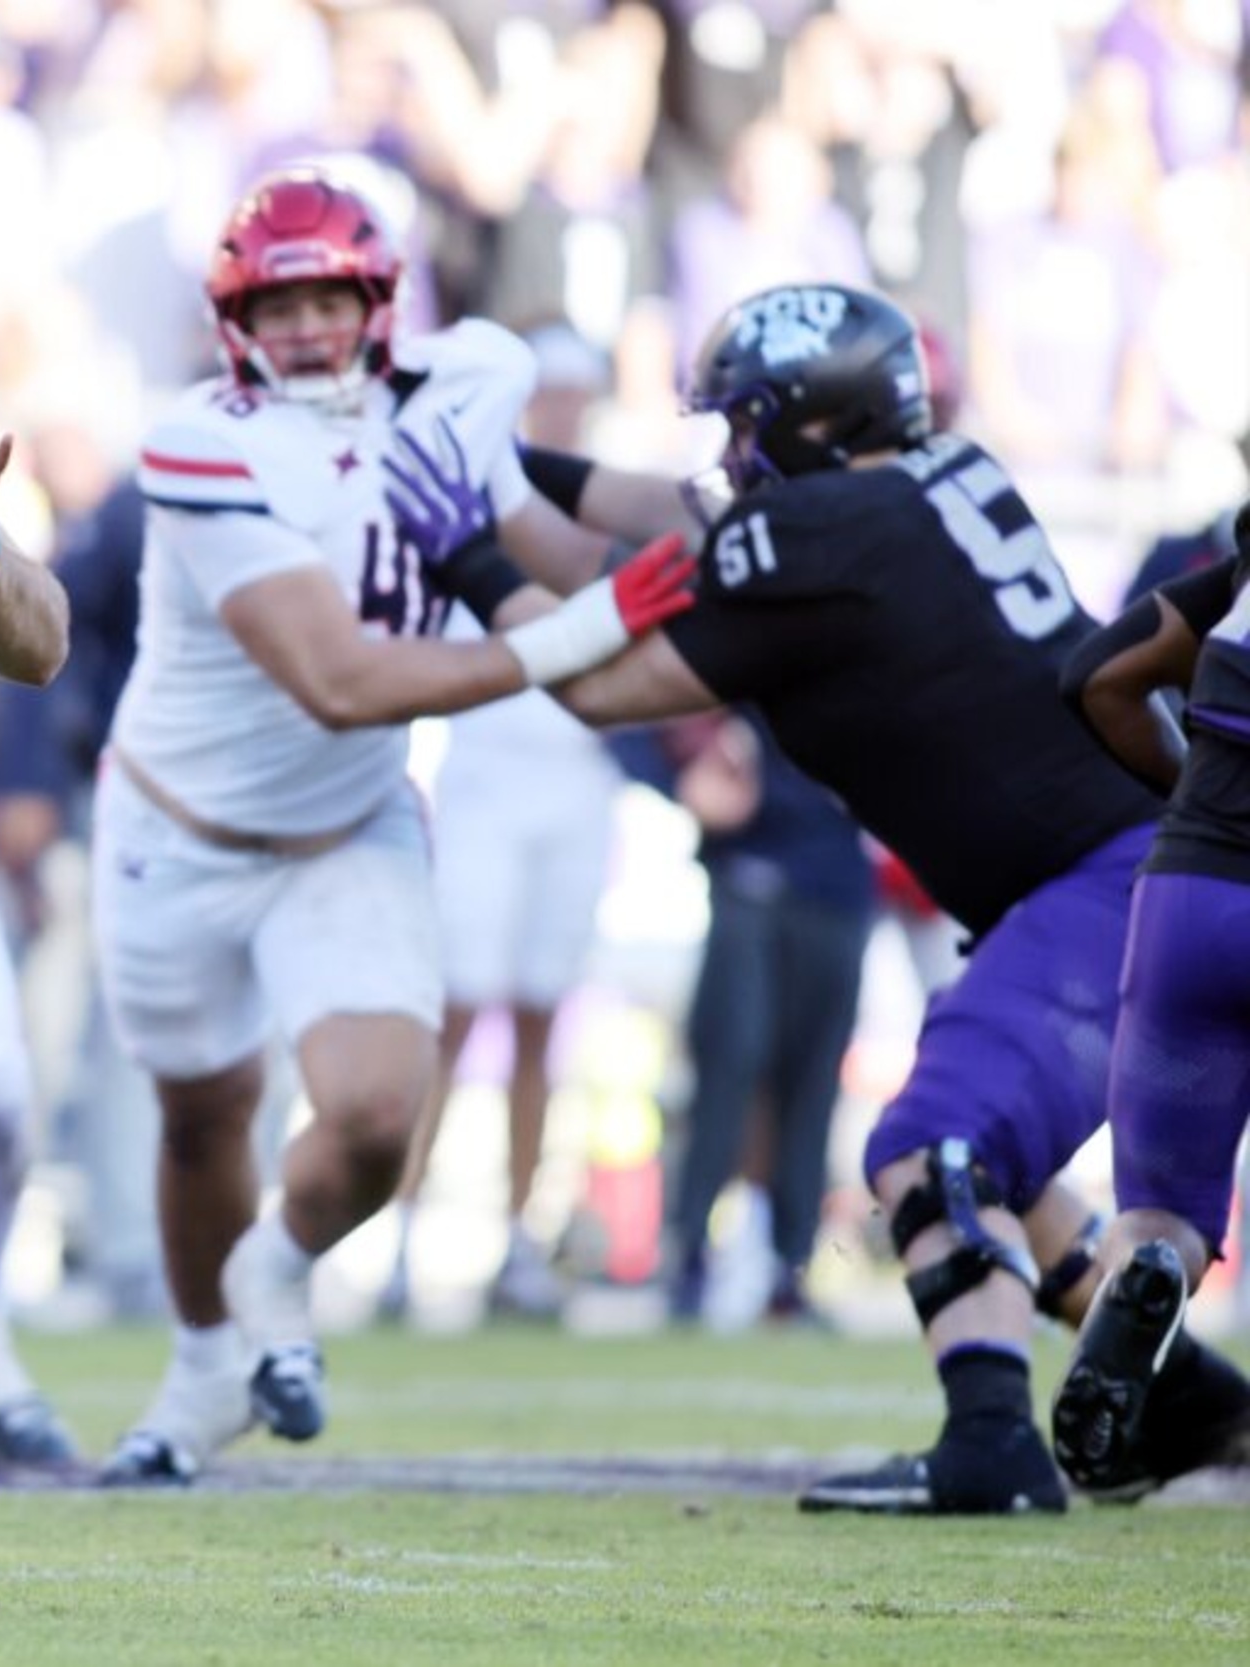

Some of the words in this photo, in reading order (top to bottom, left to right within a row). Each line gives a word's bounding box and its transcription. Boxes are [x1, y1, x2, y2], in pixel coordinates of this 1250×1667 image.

[736, 286, 847, 350] TCU
[359, 520, 451, 636] 4
[716, 512, 777, 587] 51
